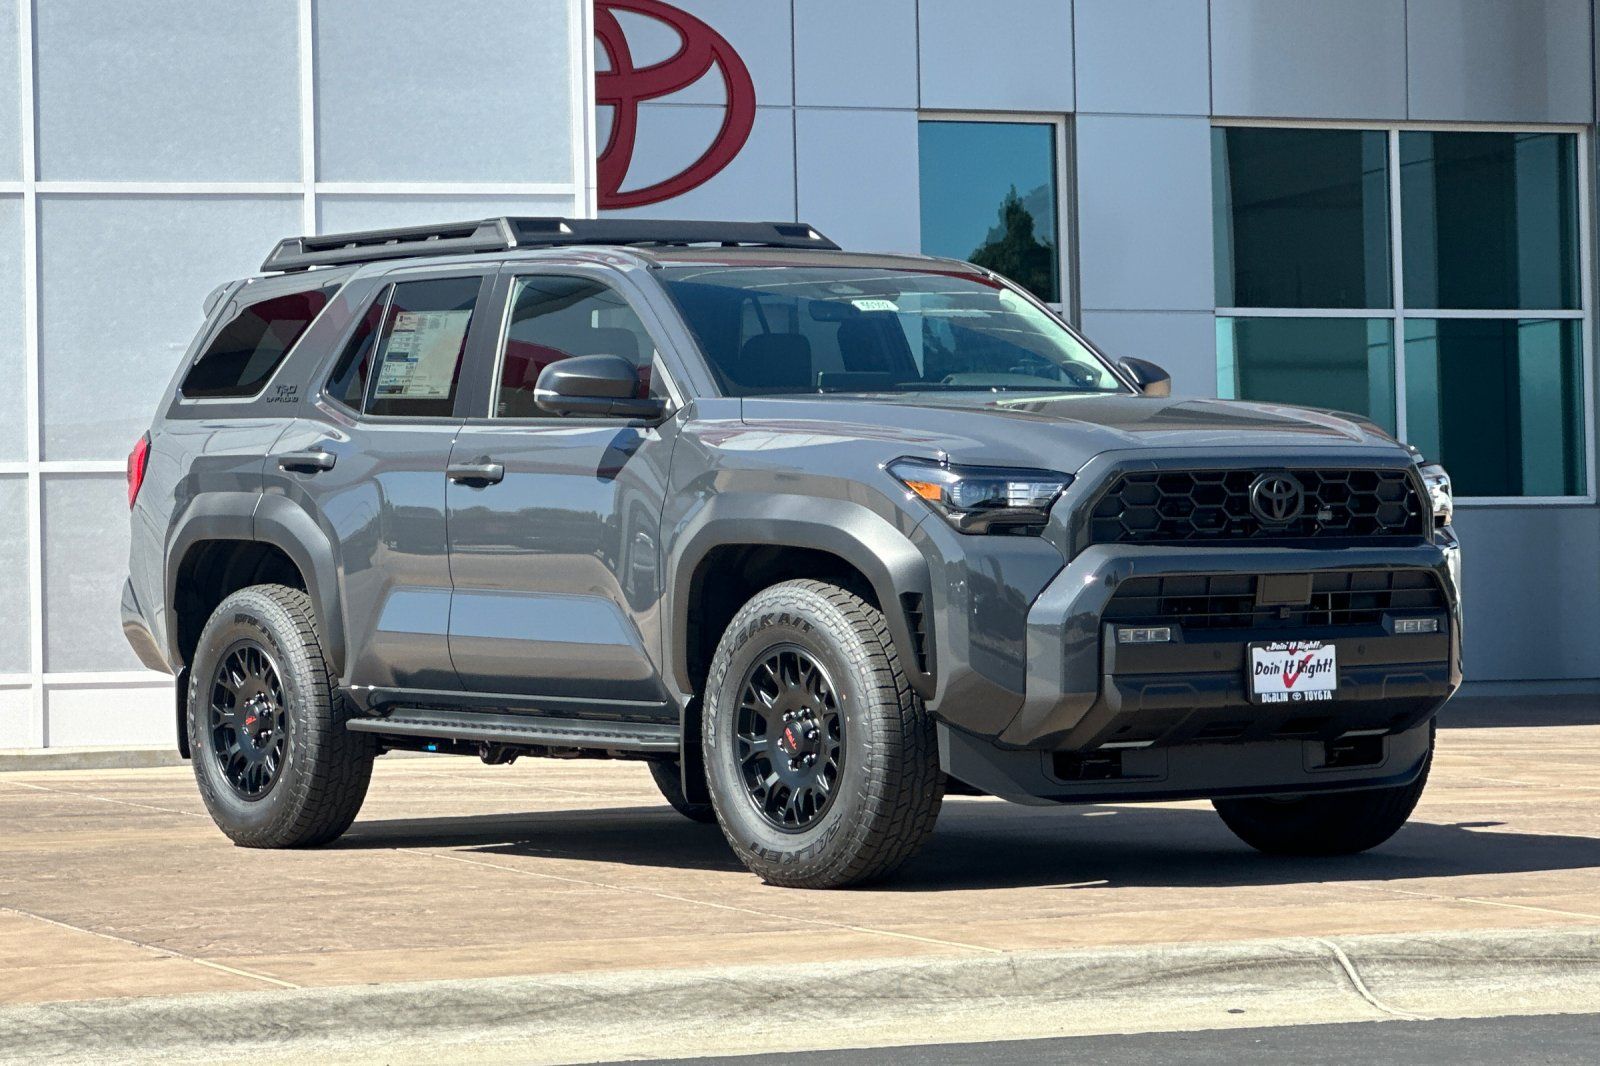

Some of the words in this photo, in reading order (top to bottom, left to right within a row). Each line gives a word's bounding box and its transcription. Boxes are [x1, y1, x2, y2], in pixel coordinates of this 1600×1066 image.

[1284, 659, 1295, 673] It
[1297, 658, 1333, 679] Right!
[1261, 692, 1289, 703] DUBLIN
[1304, 690, 1333, 701] TOYOTA
